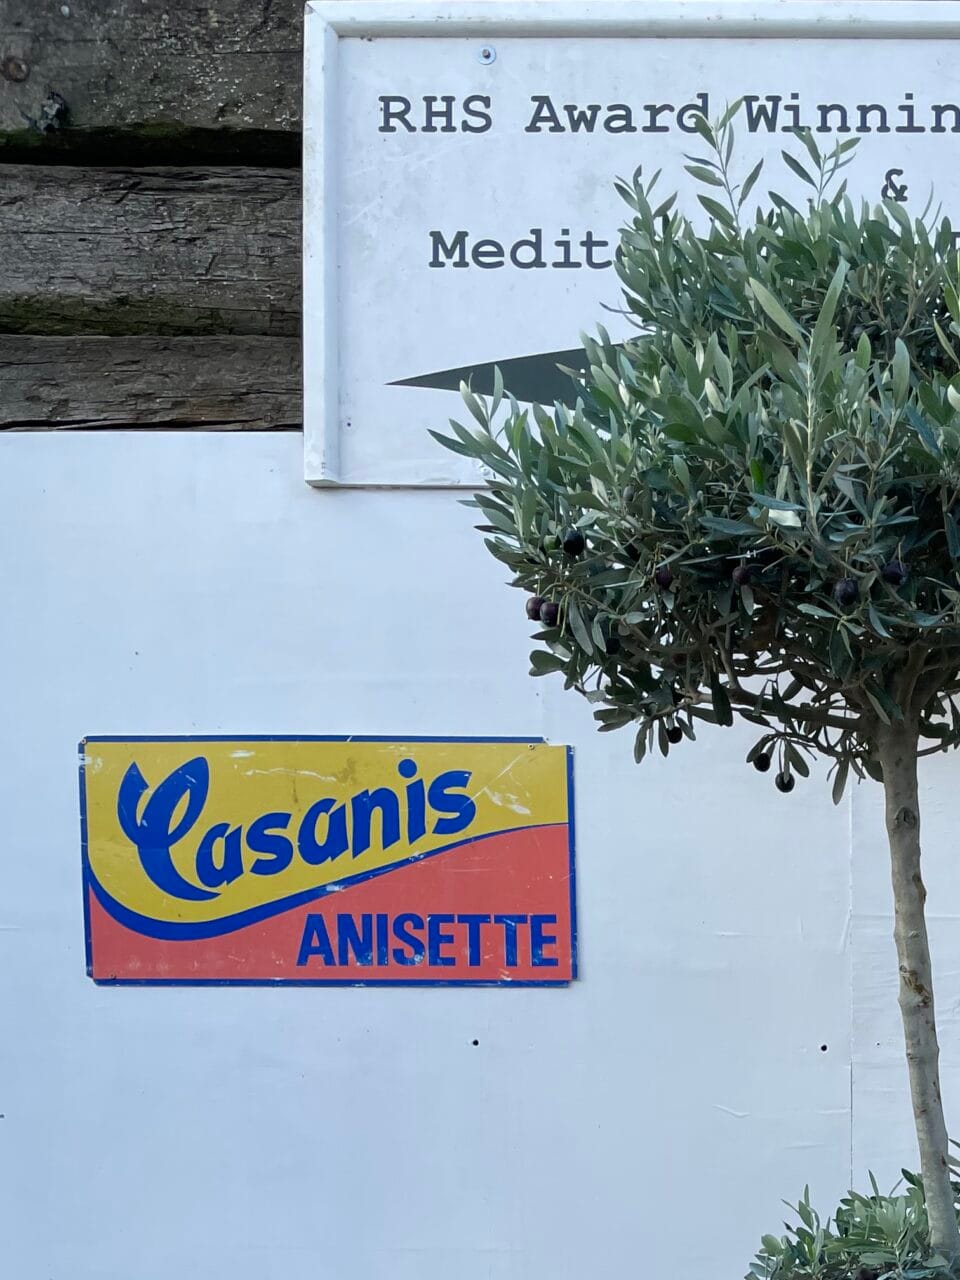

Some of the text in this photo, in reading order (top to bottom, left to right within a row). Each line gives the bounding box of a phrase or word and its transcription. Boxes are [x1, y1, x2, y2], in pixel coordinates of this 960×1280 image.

[378, 95, 493, 134] RHS
[524, 93, 709, 134] Award
[881, 168, 908, 202] &
[117, 756, 477, 901] Casanis
[297, 913, 558, 967] ANISETTE
